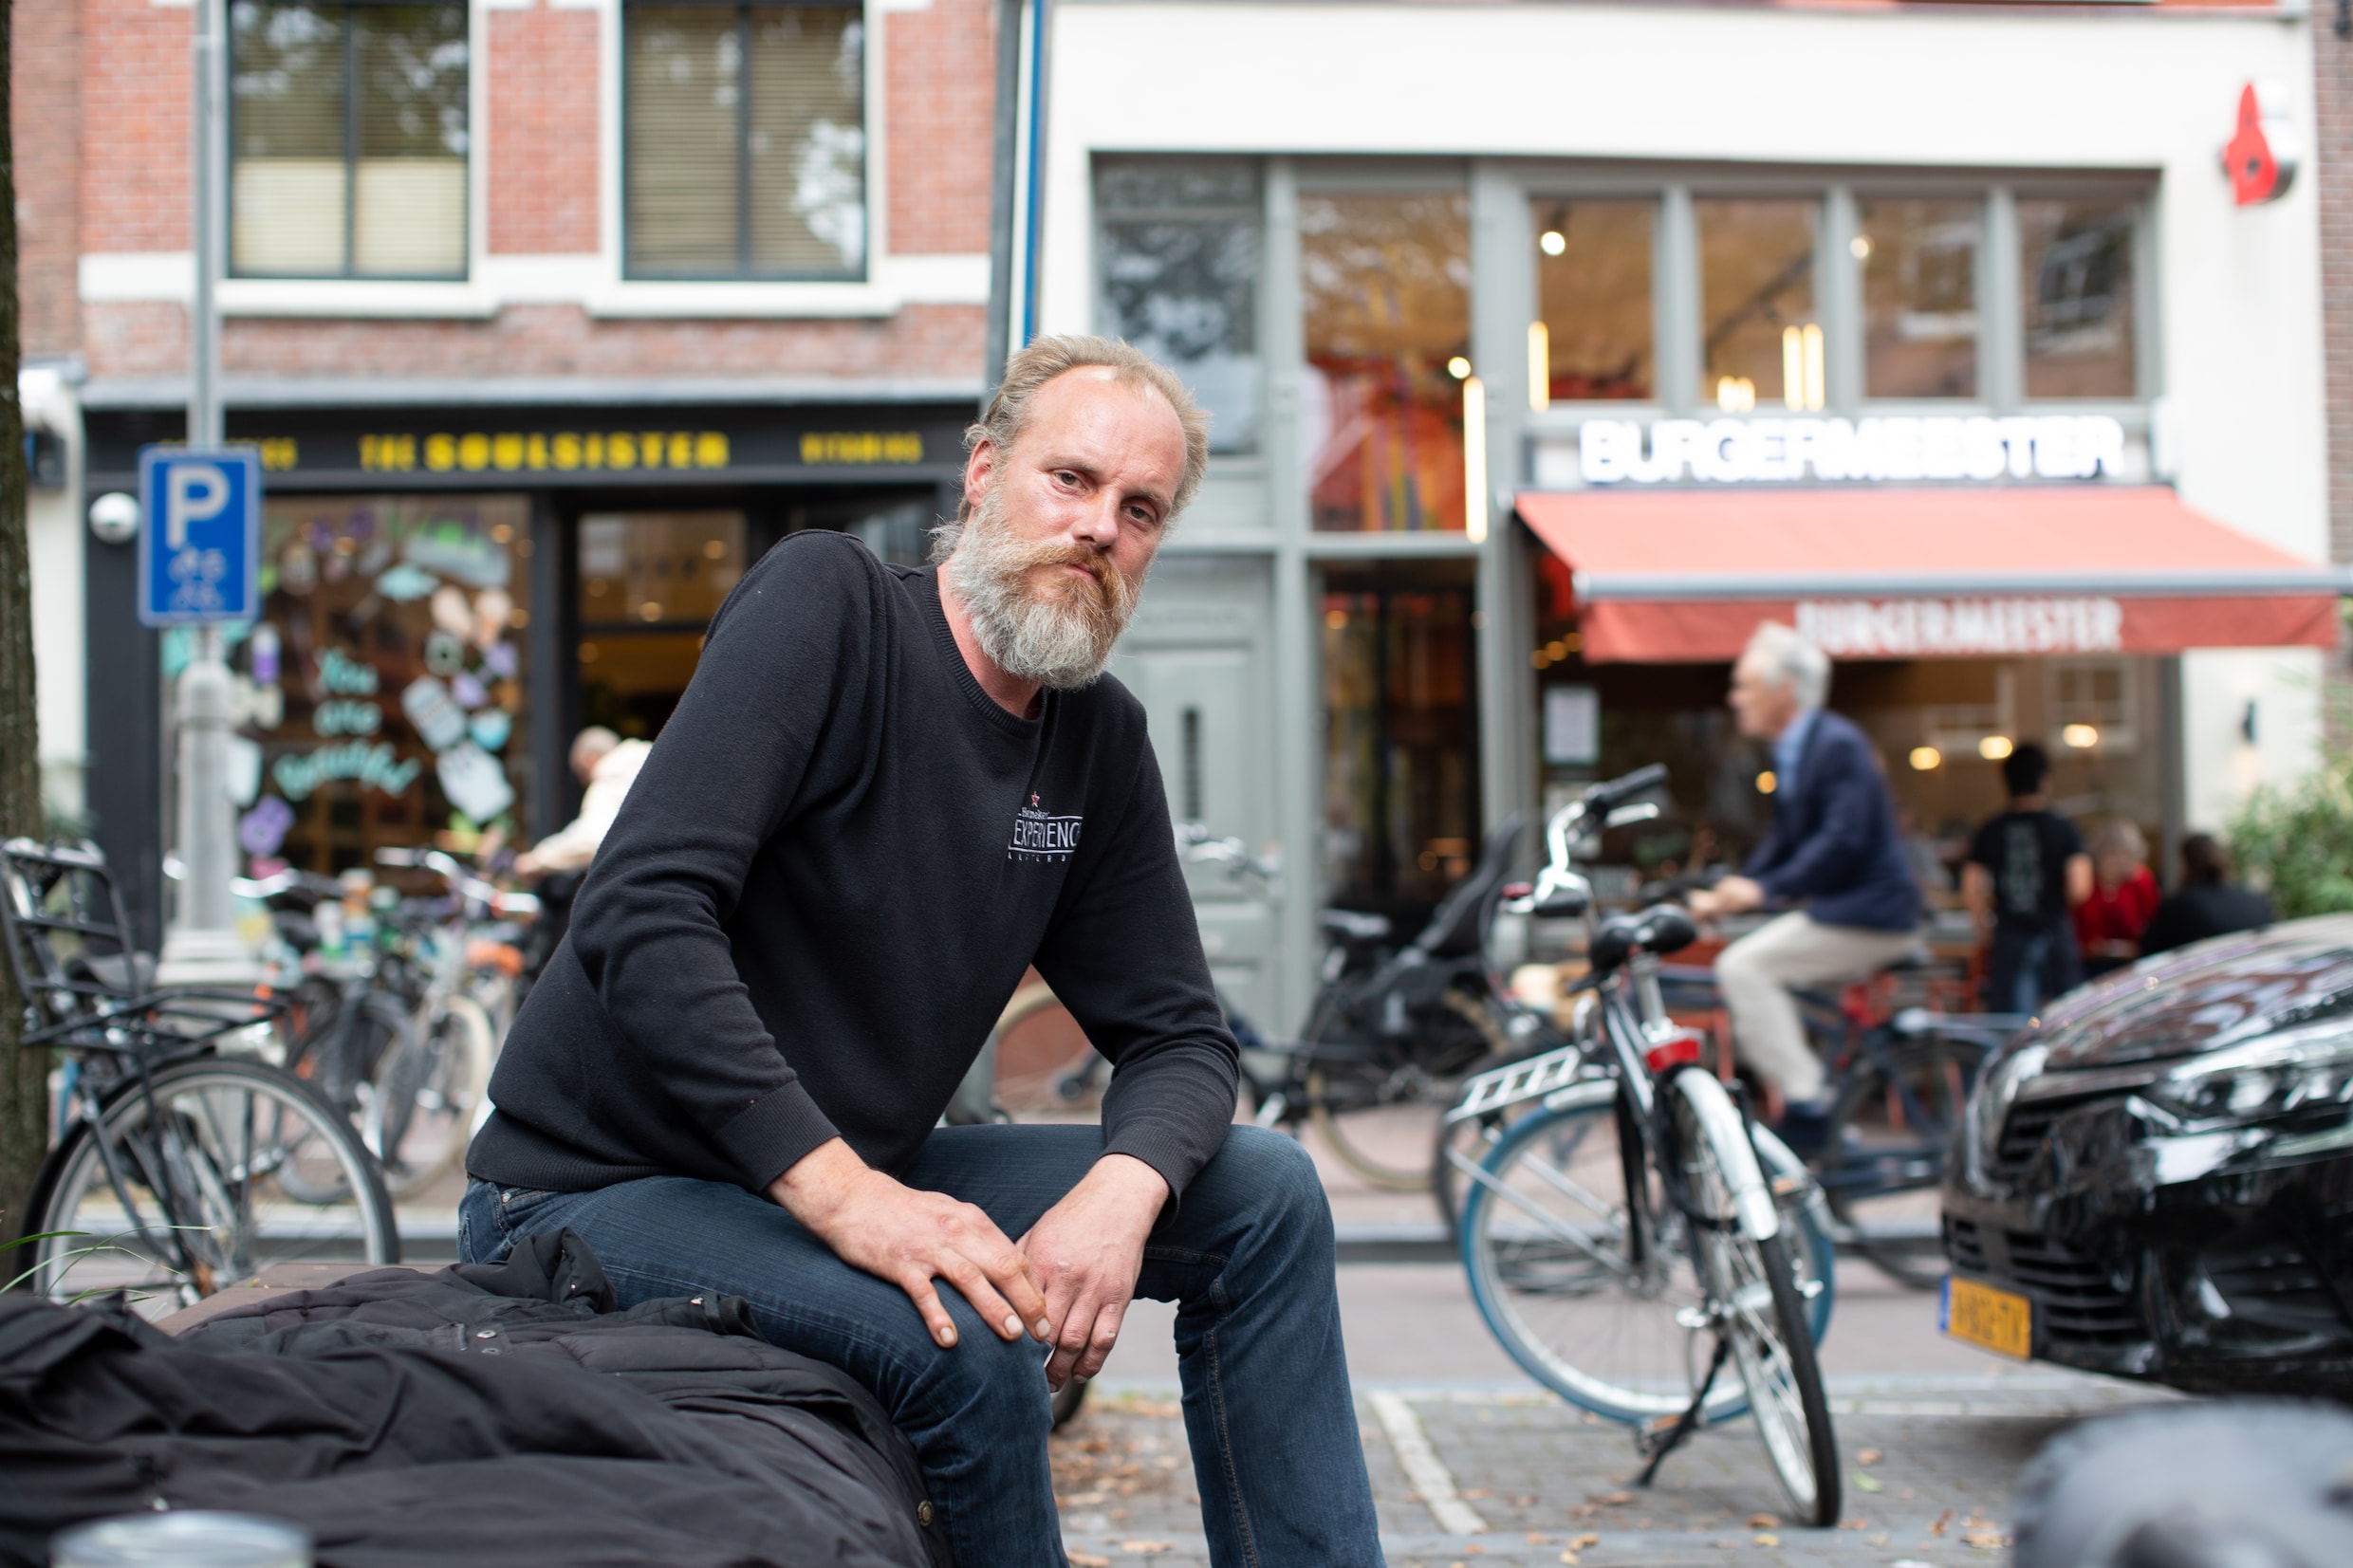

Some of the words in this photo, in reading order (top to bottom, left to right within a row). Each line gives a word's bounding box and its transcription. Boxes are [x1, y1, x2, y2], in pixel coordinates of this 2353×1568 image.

[423, 432, 729, 470] SOULSISTER
[1581, 415, 2124, 481] BURGERMEESTER
[166, 465, 230, 549] P
[1012, 819, 1082, 848] EXPERIENC
